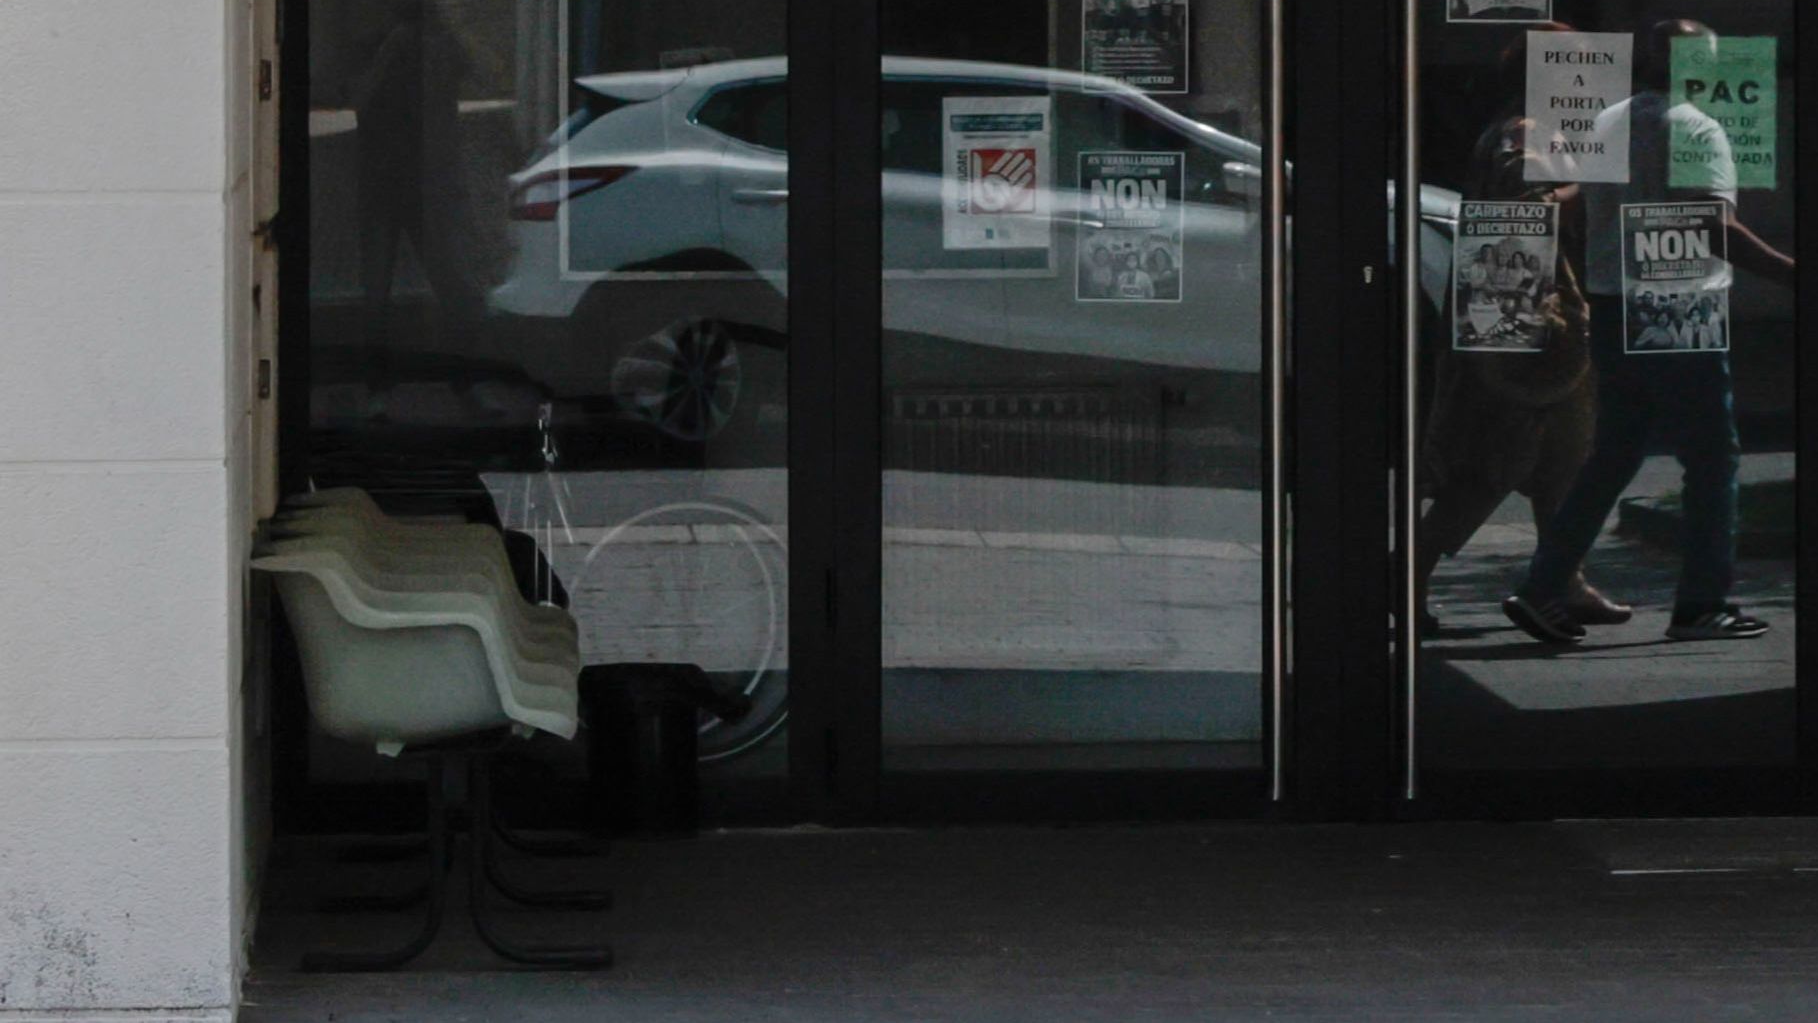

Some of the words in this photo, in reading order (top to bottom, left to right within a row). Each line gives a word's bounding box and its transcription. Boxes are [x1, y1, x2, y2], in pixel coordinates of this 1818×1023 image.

[1544, 50, 1615, 65] PECHEN
[1573, 74, 1584, 87] A
[1685, 79, 1760, 104] PAC
[1550, 96, 1607, 110] PORTA
[1560, 118, 1595, 132] POR
[1740, 116, 1759, 128] DE
[1549, 141, 1605, 155] FAVOR
[1090, 178, 1167, 209] NON
[1464, 204, 1547, 219] CARPETAZO
[1476, 222, 1547, 235] DECRETAZO
[1634, 229, 1711, 262] NON
